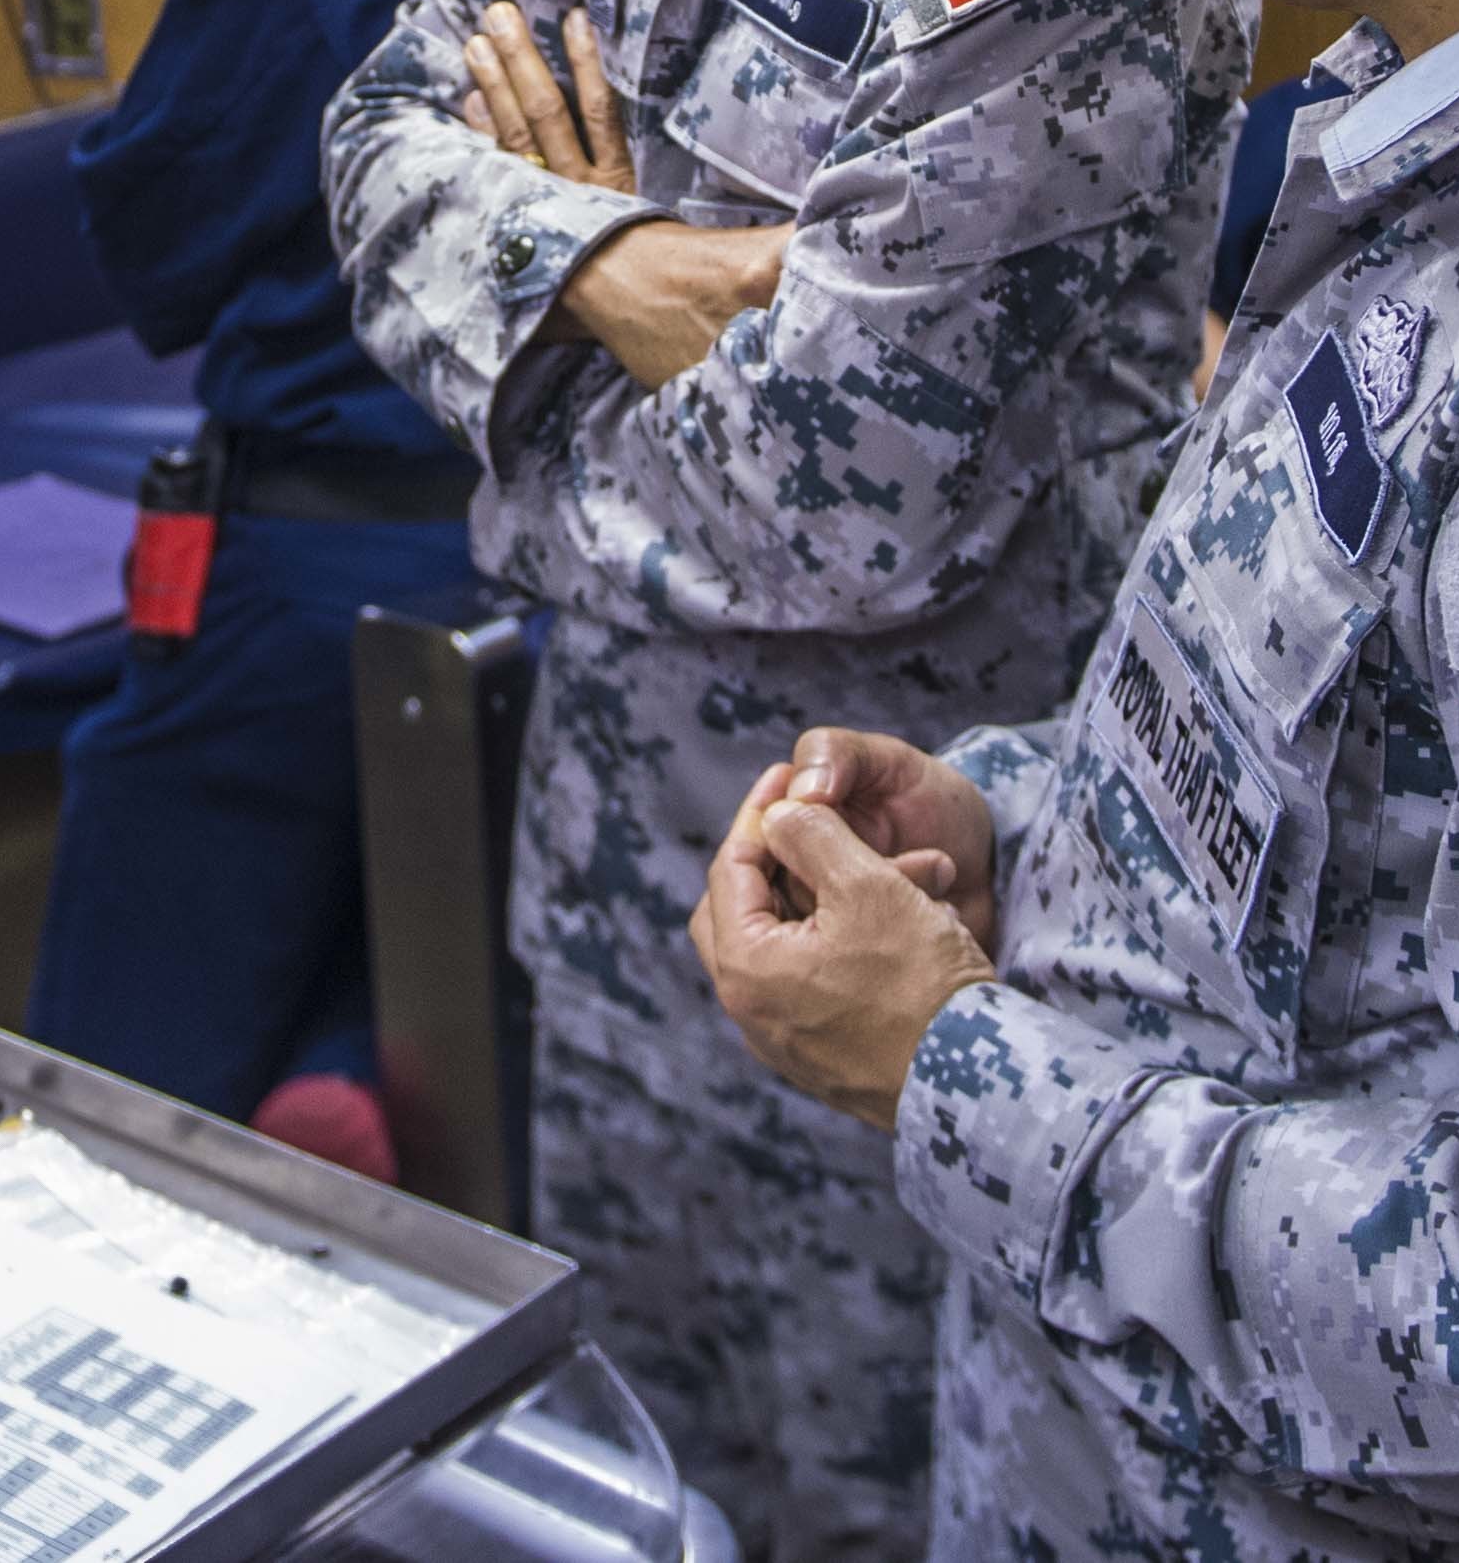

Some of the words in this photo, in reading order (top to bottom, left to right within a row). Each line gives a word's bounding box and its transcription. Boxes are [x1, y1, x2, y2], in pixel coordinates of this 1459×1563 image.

[1108, 638, 1172, 766] ROYAL
[1160, 714, 1212, 827] THAI
[1197, 774, 1261, 904] FLEET
